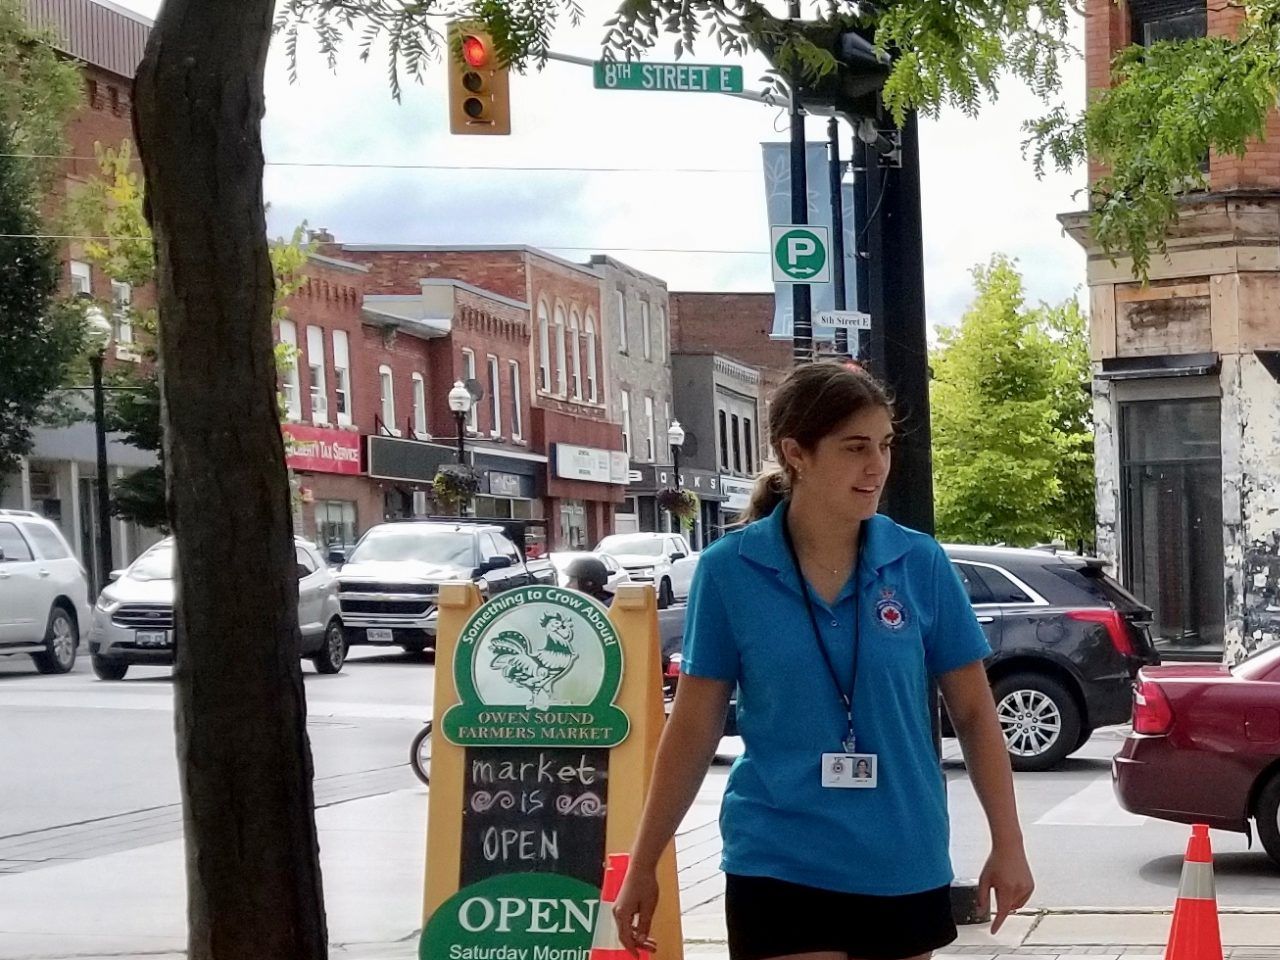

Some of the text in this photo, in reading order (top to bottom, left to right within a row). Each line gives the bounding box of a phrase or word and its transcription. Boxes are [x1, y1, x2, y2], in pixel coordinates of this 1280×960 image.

[605, 63, 732, 91] 8TH STREET E
[788, 237, 815, 265] P
[837, 317, 860, 326] Street
[863, 318, 869, 327] E
[463, 590, 617, 646] Something to Crow About!
[478, 712, 594, 725] OWEN SOUND
[458, 727, 613, 739] FARMERS MARKET
[472, 753, 596, 785] market
[482, 826, 560, 861] OPEN
[458, 897, 599, 933] OPEN
[533, 945, 592, 960] Mornin
